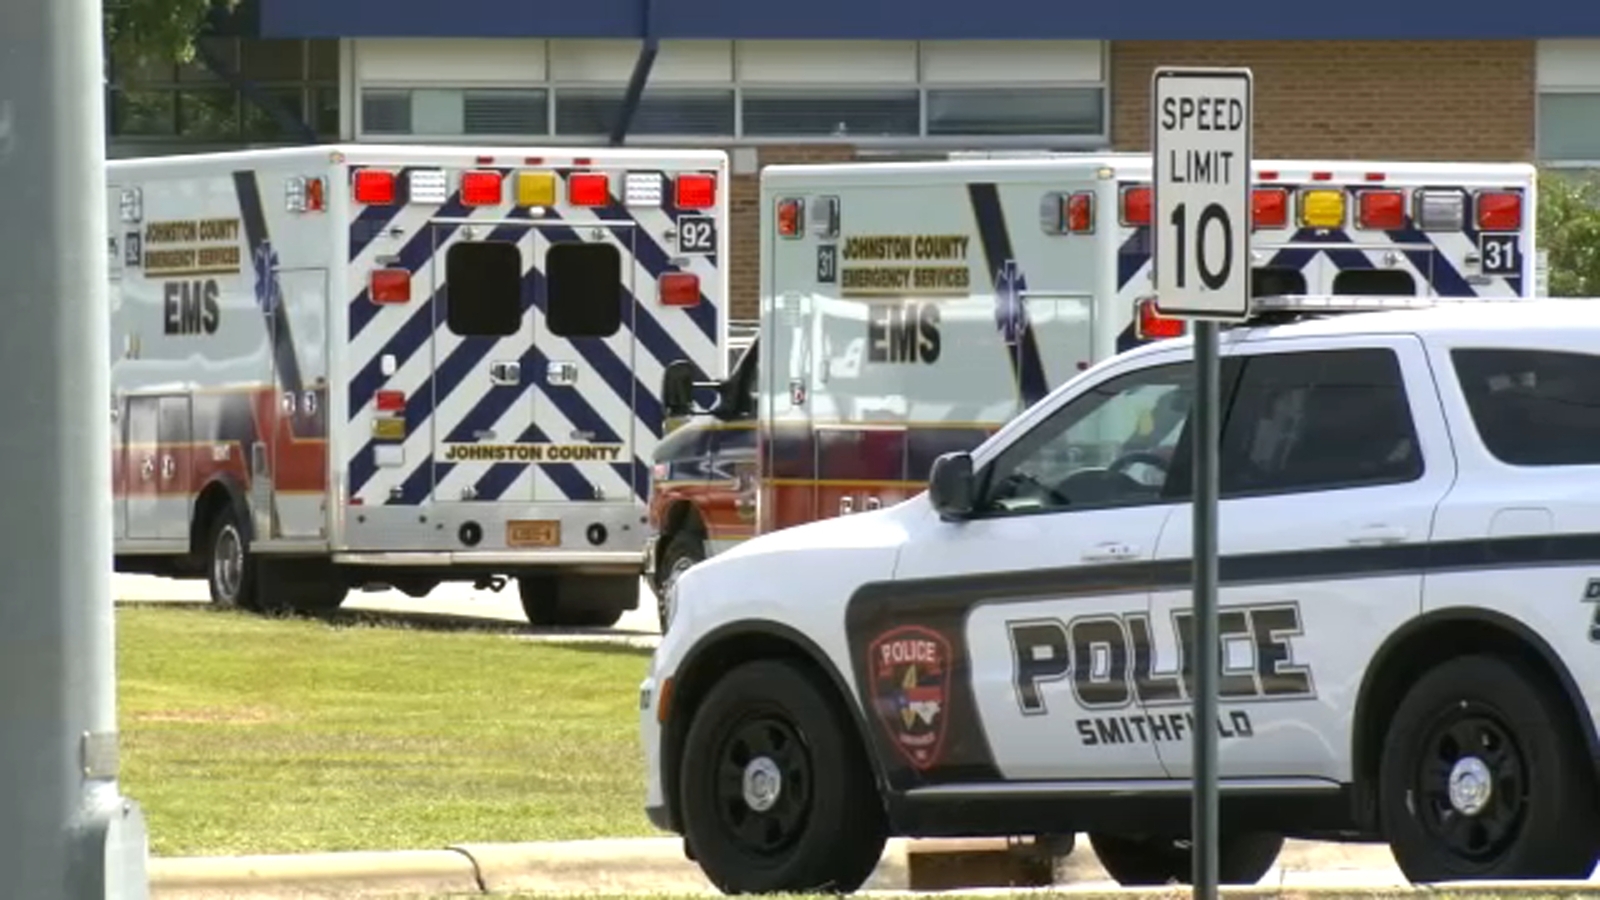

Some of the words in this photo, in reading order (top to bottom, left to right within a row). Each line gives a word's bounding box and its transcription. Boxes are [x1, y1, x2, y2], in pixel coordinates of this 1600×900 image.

[1161, 96, 1244, 131] SPEED
[1170, 149, 1234, 184] LIMIT
[144, 220, 197, 243] JOHNSTON
[200, 218, 240, 241] COUNTY
[681, 221, 712, 249] 92
[842, 235, 911, 261] JOHNSTON
[914, 235, 969, 261] COUNTY
[1170, 202, 1234, 290] 10
[1484, 240, 1514, 270] 31
[818, 251, 833, 277] 31
[841, 266, 911, 289] EMERGENCY
[914, 266, 969, 288] SERVICES
[164, 279, 220, 336] EMS
[867, 303, 942, 365] EMS
[445, 444, 542, 461] JOHNSTON
[547, 444, 621, 461] COUNTY
[880, 640, 937, 665] POLICE
